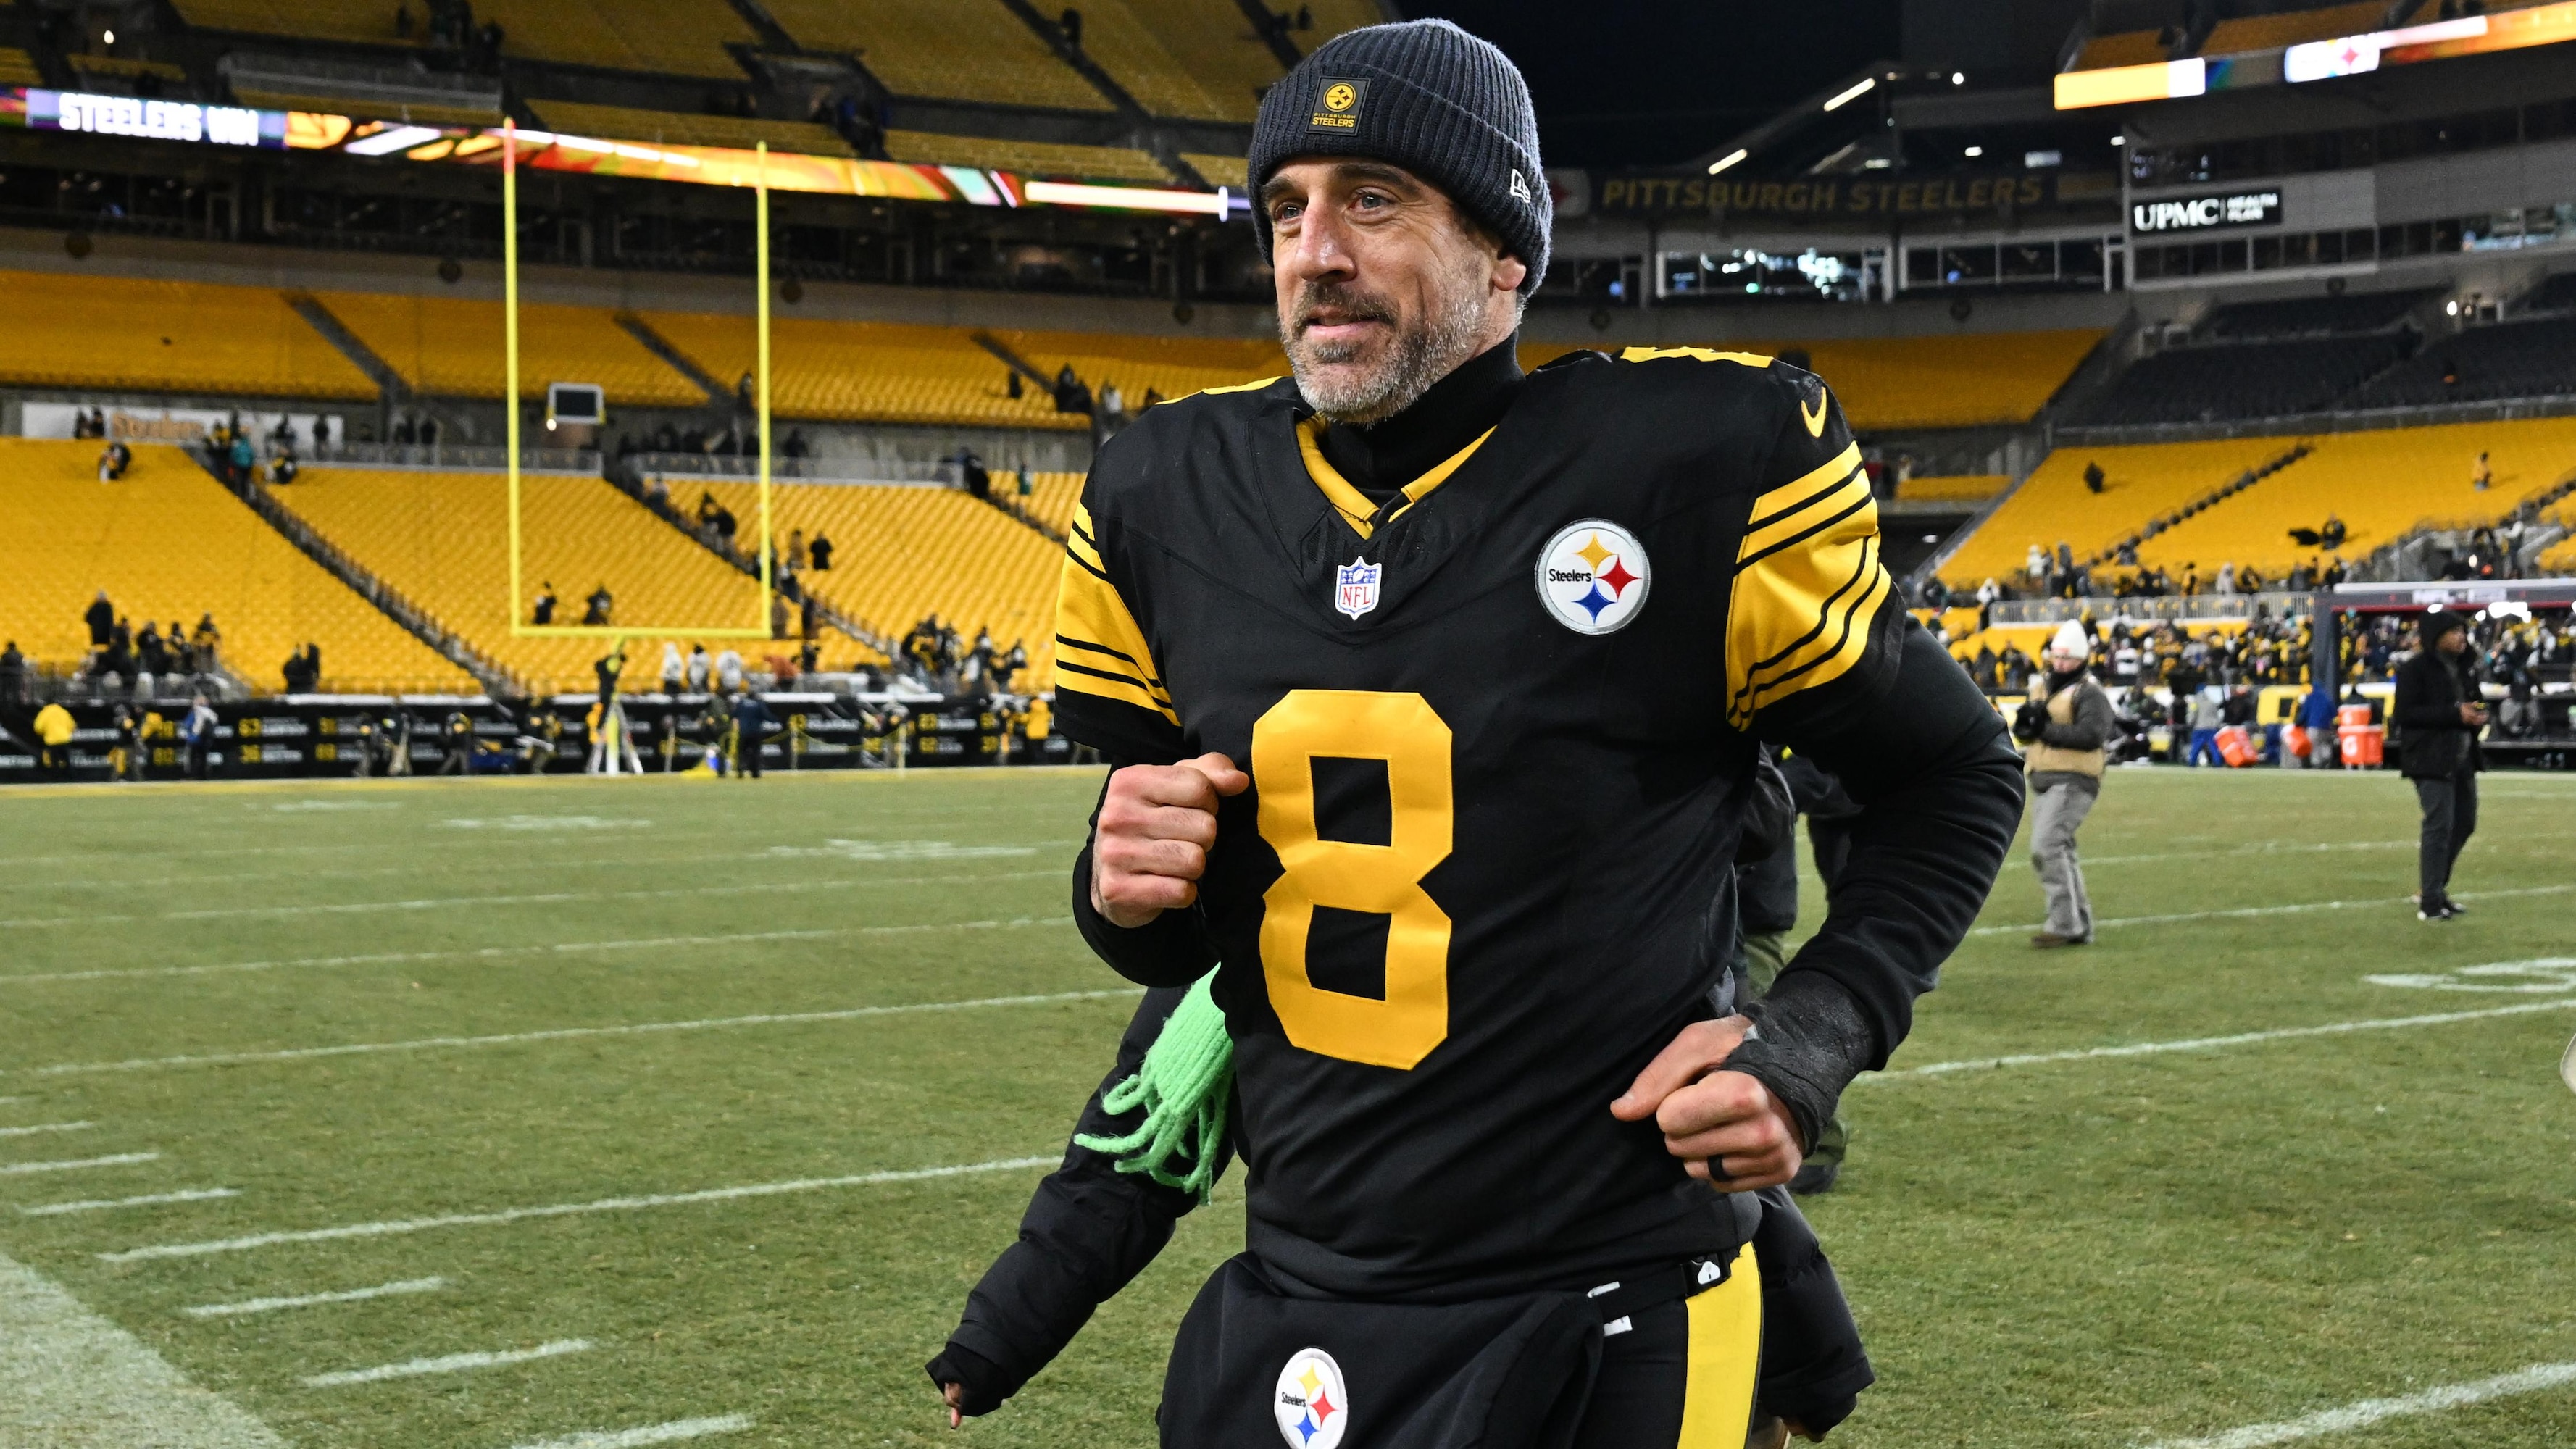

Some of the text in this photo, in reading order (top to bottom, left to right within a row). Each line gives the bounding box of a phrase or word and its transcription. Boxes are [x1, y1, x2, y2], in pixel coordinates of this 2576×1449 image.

[59, 92, 259, 146] STEELERS WIN
[1312, 117, 1355, 128] STEELERS
[1601, 177, 2045, 212] PITTSBURGH STEELERS
[2134, 198, 2219, 231] UPMC
[1548, 569, 1592, 582] Steelers
[1342, 586, 1370, 608] NFL
[1251, 689, 1454, 1070] 8
[1281, 1391, 1306, 1408] Steelers
